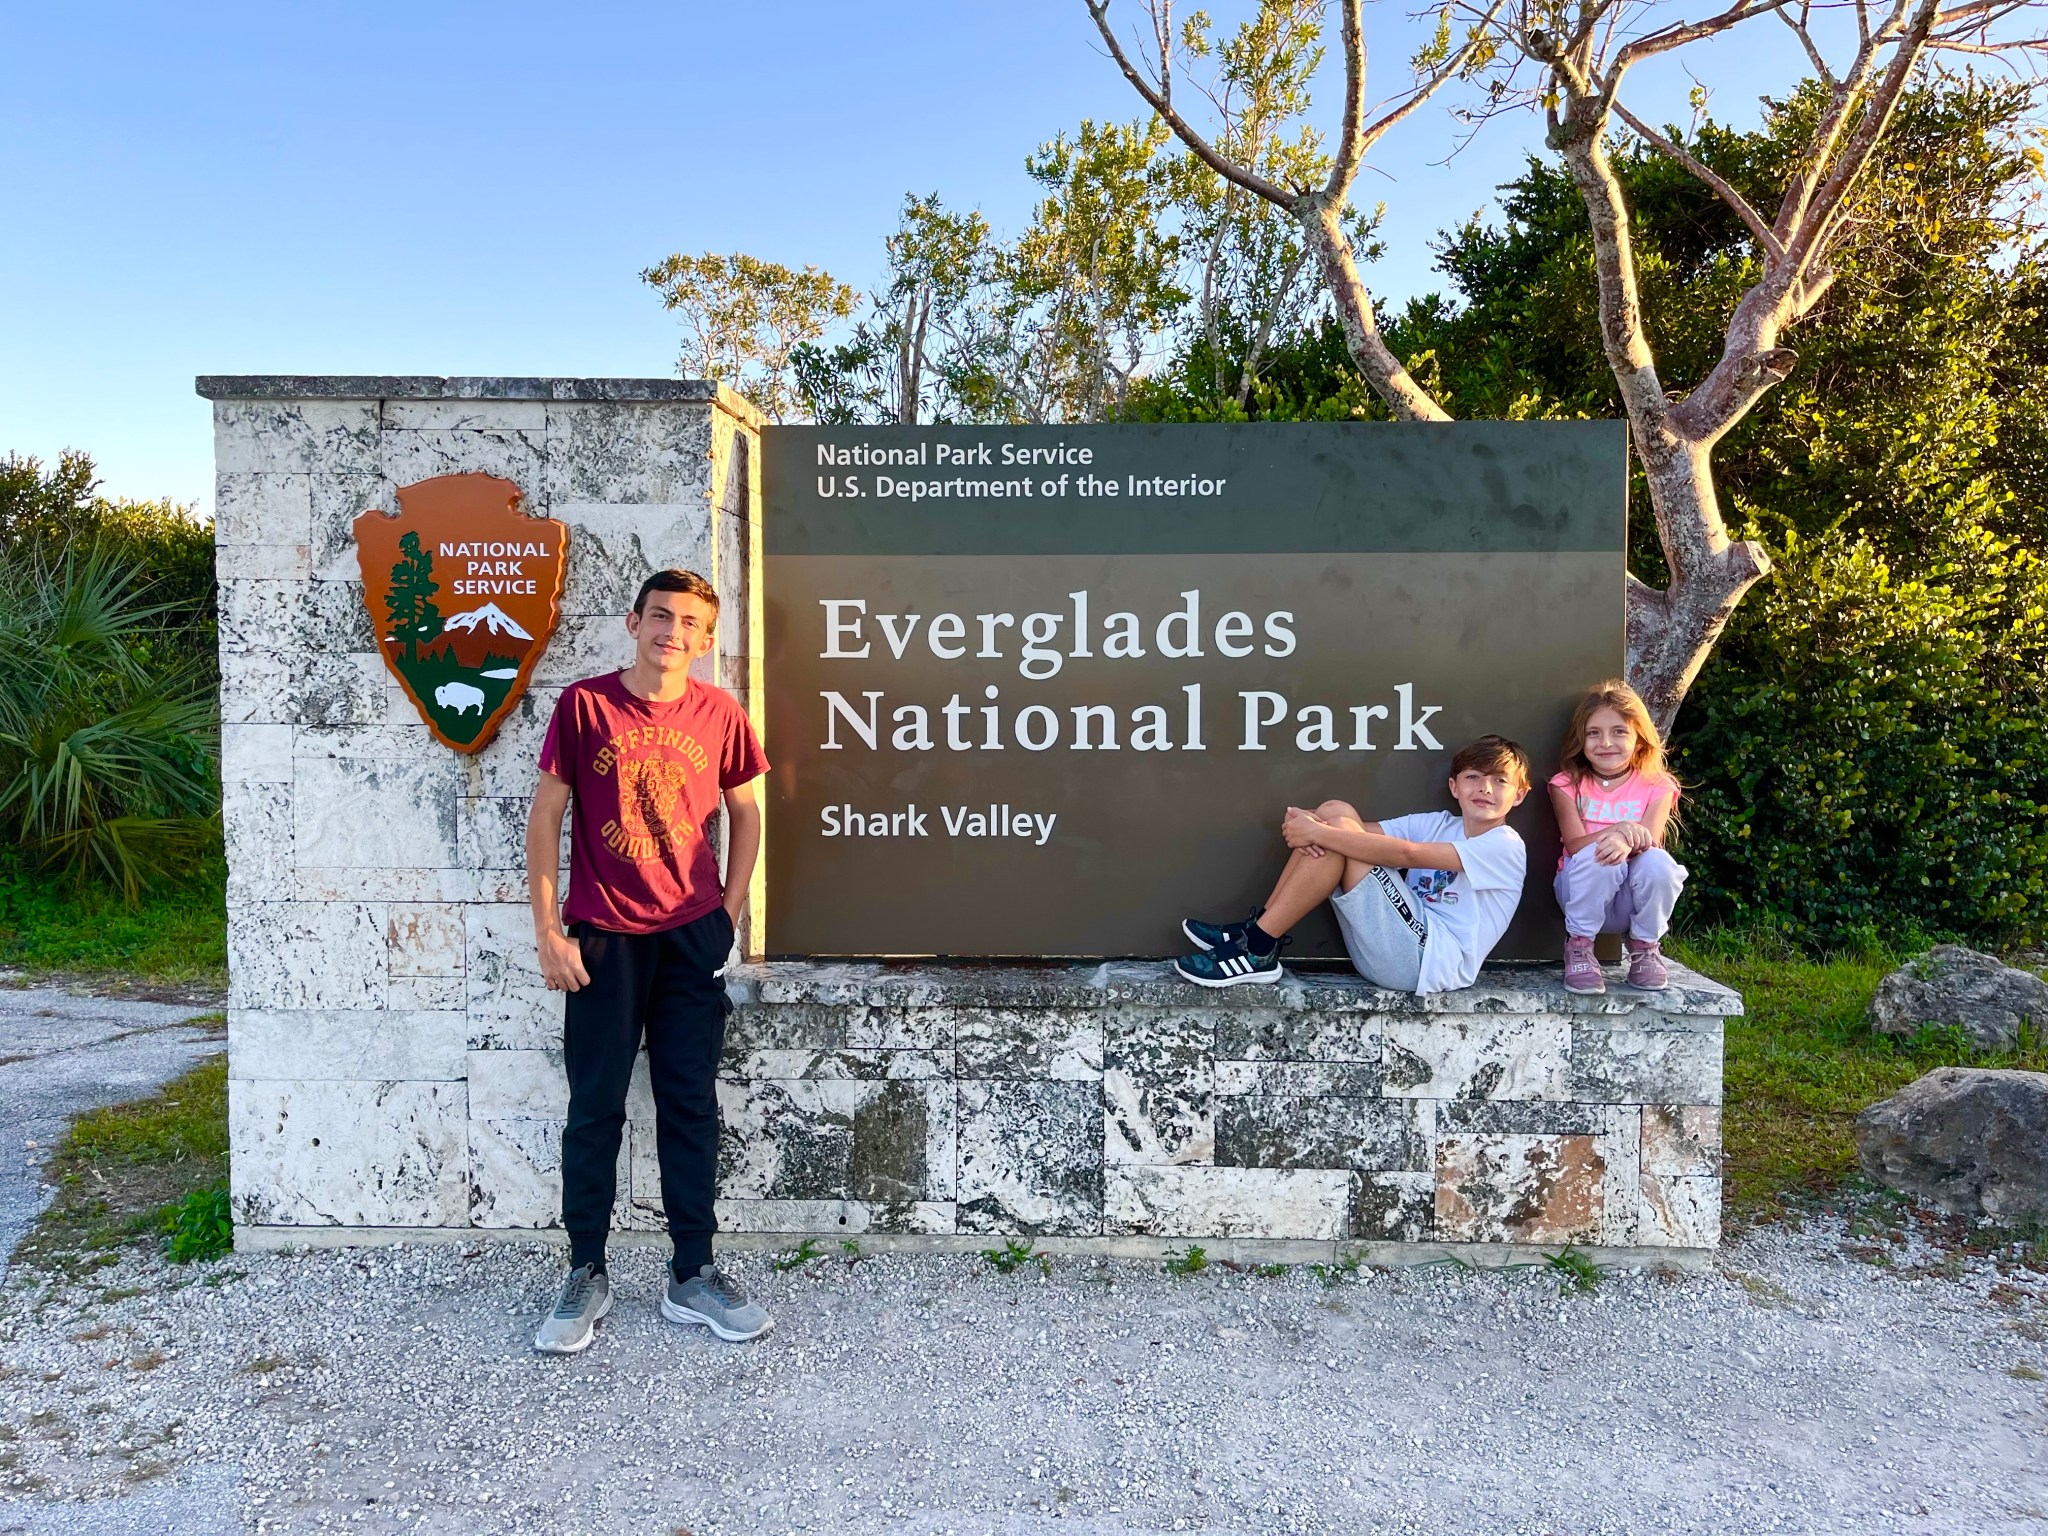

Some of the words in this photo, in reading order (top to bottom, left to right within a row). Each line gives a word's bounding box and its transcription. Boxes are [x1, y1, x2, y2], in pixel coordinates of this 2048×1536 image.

[818, 443, 926, 465] National
[937, 443, 992, 465] Park
[1002, 443, 1092, 465] Service
[818, 476, 866, 497] U.S.
[877, 475, 1032, 502] Department
[1041, 474, 1068, 497] of
[1076, 474, 1119, 496] the
[1129, 474, 1226, 496] Interior
[439, 542, 550, 557] NATIONAL
[467, 561, 523, 576] PARK
[454, 580, 536, 594] SERVICE
[820, 589, 1296, 679] Everglades
[820, 684, 1206, 751] National
[1239, 683, 1443, 751] Park
[592, 726, 709, 776] GRYFFINDOR
[1577, 796, 1641, 821] PEACE
[822, 804, 928, 836] Shark
[941, 805, 1056, 845] Valley
[600, 819, 694, 859] QUIDDITCH
[1377, 870, 1405, 908] KENNETH
[1407, 916, 1425, 936] COLE
